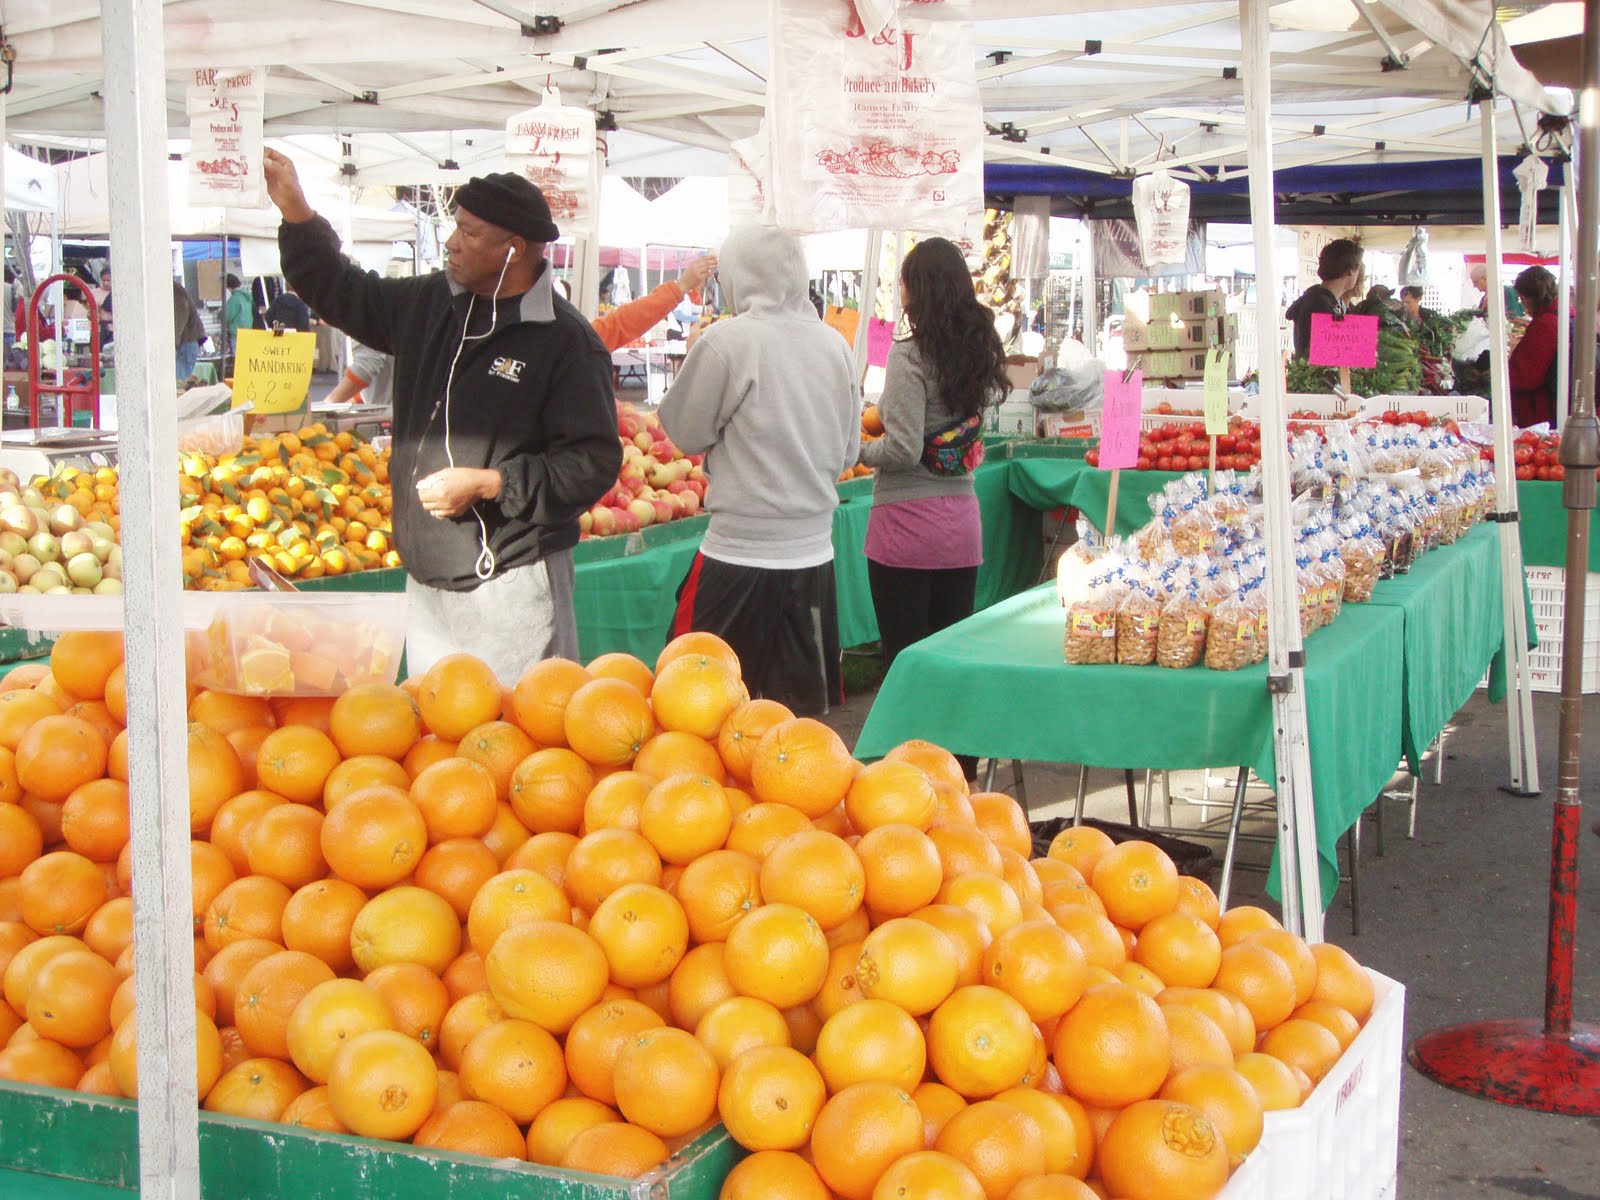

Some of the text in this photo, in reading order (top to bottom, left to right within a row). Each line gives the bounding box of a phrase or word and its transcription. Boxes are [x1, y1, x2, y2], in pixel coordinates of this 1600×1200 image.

[899, 31, 920, 72] J
[196, 68, 219, 87] FAR
[843, 75, 881, 93] Produce
[901, 76, 938, 98] Bakery
[263, 346, 292, 357] SWEET
[248, 358, 307, 375] MANDARINS
